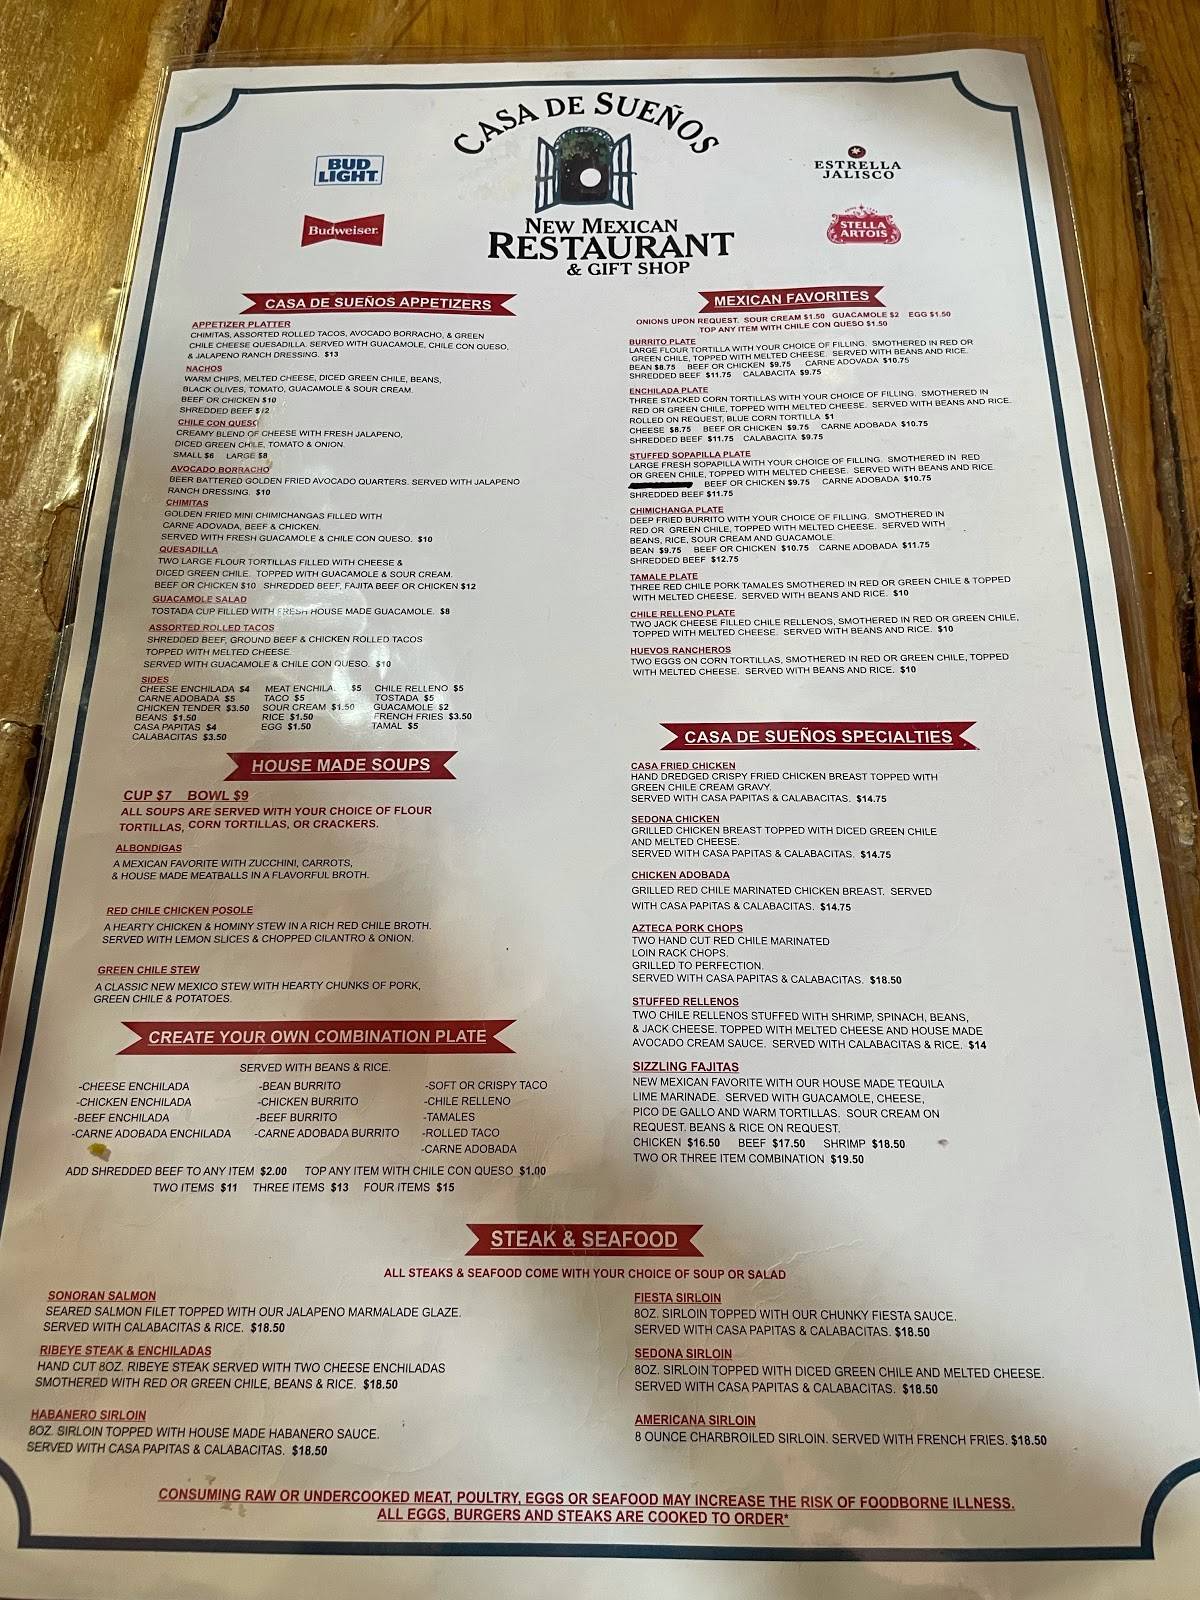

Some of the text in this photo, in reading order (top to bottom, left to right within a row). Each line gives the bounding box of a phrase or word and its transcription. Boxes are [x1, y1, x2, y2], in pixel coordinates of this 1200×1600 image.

[454, 91, 719, 155] CASA DE SUEÑOS
[327, 159, 370, 171] BUD
[814, 159, 901, 171] ESTRELLA
[318, 170, 377, 183] LIGHT
[823, 169, 895, 180] JALISCO
[525, 217, 679, 234] NEW MEXICAN
[840, 221, 886, 229] STELLA
[840, 229, 888, 238] ARTOIS
[488, 230, 735, 260] RESTAURANT
[567, 260, 690, 276] & GIFT SHOP
[265, 296, 491, 311] CASA DE SUEÑOS APPETIZERS
[714, 290, 869, 306] MEXICAN FAVORITES
[192, 320, 293, 328] APPETIZER PLATTER
[634, 318, 668, 326] ONIONS
[671, 317, 695, 325] UPON
[697, 316, 740, 324] REQUEST.
[743, 315, 767, 323] SOUR
[832, 312, 886, 320] GUACAMOLE
[908, 311, 927, 319] EGG
[189, 331, 231, 340] CHIMITAS,
[233, 331, 280, 339] ASSORTED
[316, 332, 347, 340] TACOS,
[393, 332, 445, 341] BORRACHO,
[446, 332, 452, 340] &
[454, 332, 486, 340] GREEN
[681, 386, 708, 394] PLATE
[629, 451, 669, 459] STUFFED
[722, 450, 750, 458] PLATE
[166, 499, 208, 507] CHIMITAS
[159, 546, 218, 555] QUESADILLA
[669, 572, 697, 580] PLATE
[631, 593, 655, 601] WITH
[696, 592, 736, 600] CHEESE.
[742, 591, 779, 599] SERVED
[807, 590, 839, 598] BEANS
[841, 590, 860, 598] AND
[893, 589, 908, 597] $10
[628, 646, 730, 654] HUEVOS RANCHEROS
[684, 727, 952, 744] CASA DE SUEÑOS SPECIALTIES
[252, 758, 430, 773] HOUSE MADE SOUPS
[124, 790, 249, 800] CUP $7 BOWL $9
[121, 806, 434, 816] ALL SOUPS ARE SERVED WITH YOUR CHOICE OF FLOUR
[631, 815, 719, 823] SEDONA CHICKEN
[115, 844, 182, 852] ALBONDIGAS
[632, 924, 742, 932] AZTECA PORK CHOPS
[95, 965, 200, 974] GREEN CHILE STEW
[148, 1030, 487, 1044] CREATE YOUR OWN COMBINATION PLATE
[632, 1062, 739, 1071] SIZZLING FAJITAS
[293, 1081, 341, 1091] BURRITO
[633, 1138, 906, 1149] CHICKEN $16.50 BEEF $17.50 SHRIMP $18.50
[154, 1183, 454, 1193] TWO ITEMS $11 THREE ITEMS $13 FOUR ITEMS $15
[491, 1230, 678, 1248] STEAK & SEAFOOD
[47, 1291, 156, 1301] SONORAN SALMON
[634, 1292, 722, 1303] FIESTA SIRLOIN
[634, 1348, 732, 1360] SEDONA SIRLOIN
[30, 1410, 146, 1421] HABANERO SIRLOIN
[635, 1414, 755, 1426] AMERICANA SIRLOIN
[377, 1509, 402, 1521] ALL
[407, 1509, 448, 1523] EGGS,
[453, 1510, 520, 1522] BURGERS
[524, 1510, 553, 1523] AND
[557, 1511, 611, 1523] STEAKS
[615, 1511, 643, 1524] ARE
[647, 1511, 706, 1524] COOKED
[713, 1512, 732, 1524] TO
